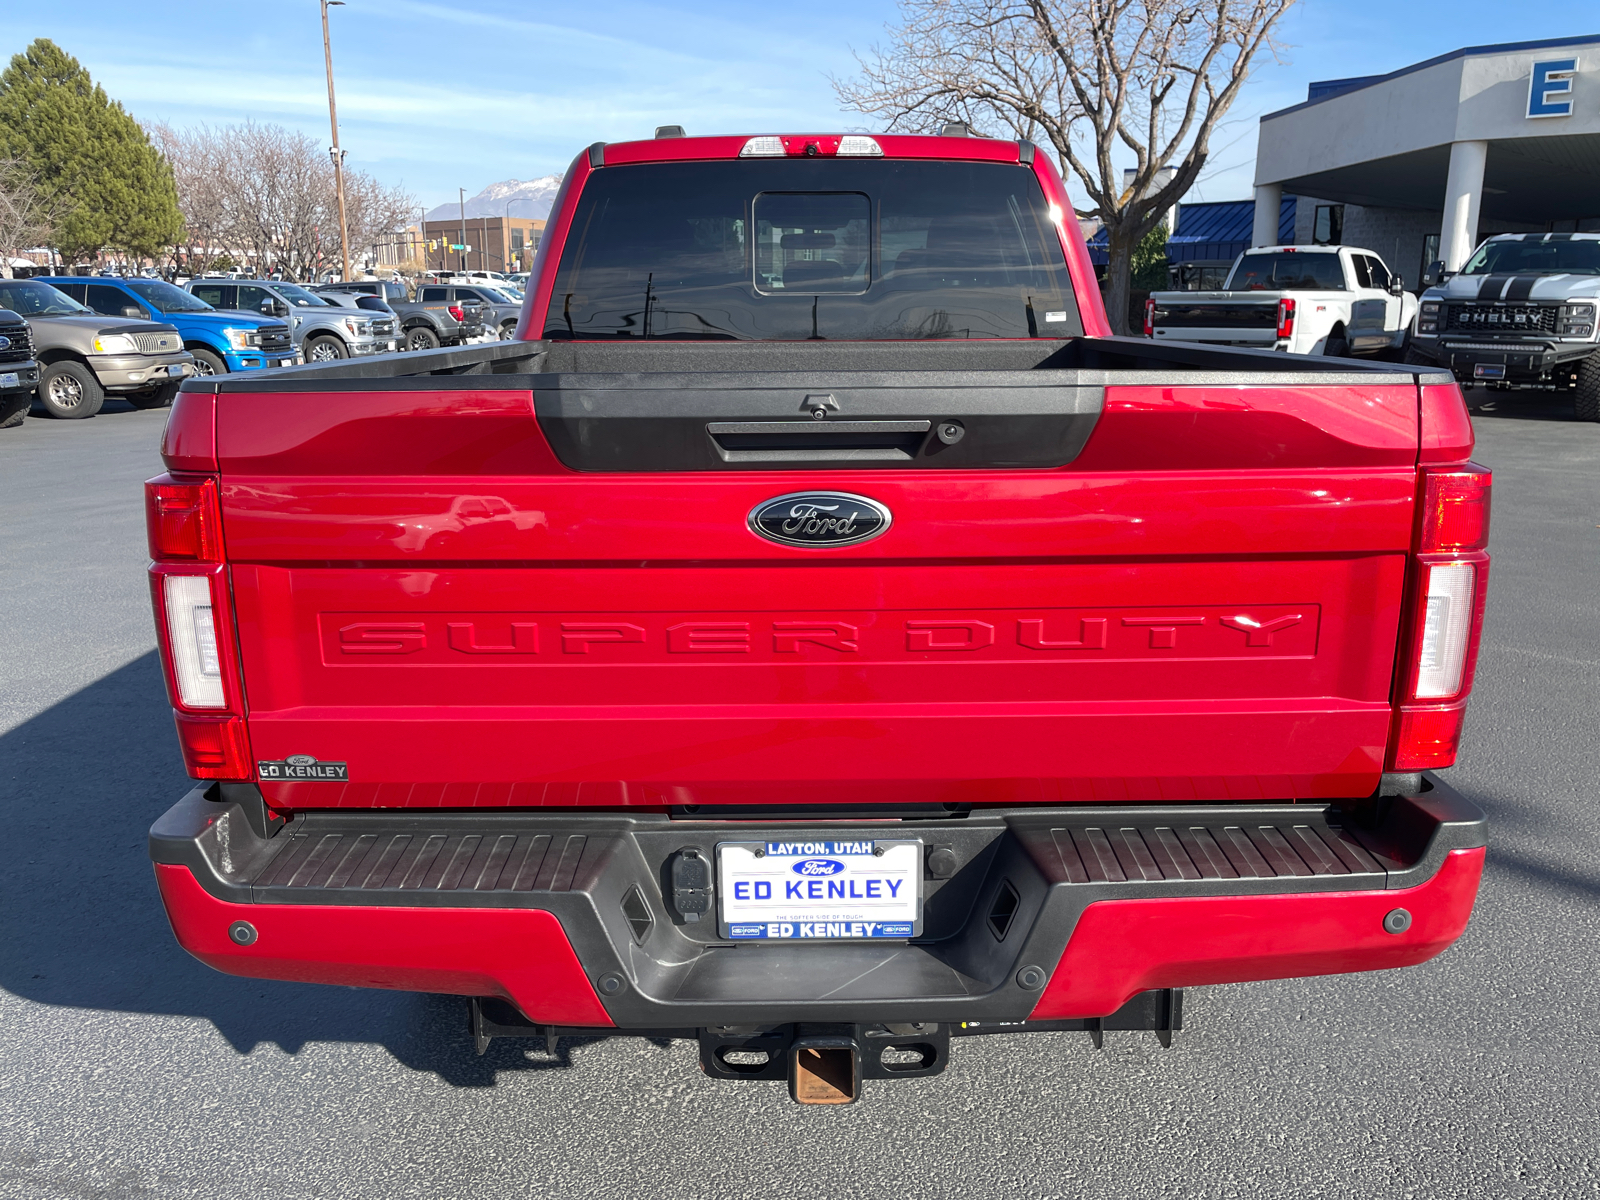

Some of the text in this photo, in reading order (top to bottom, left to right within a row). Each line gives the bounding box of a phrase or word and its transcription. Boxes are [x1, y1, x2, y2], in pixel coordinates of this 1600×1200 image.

[1525, 56, 1580, 118] E
[1460, 313, 1541, 323] SHELBY
[782, 503, 857, 535] Ford
[339, 613, 1302, 655] SUPER DUTY
[292, 757, 309, 765] Ford
[284, 766, 345, 777] KENLEY
[768, 842, 872, 855] LAYTON, UTAH
[801, 860, 835, 876] Ford
[734, 879, 903, 900] ED KENLEY
[767, 922, 876, 938] ED KENLEY
